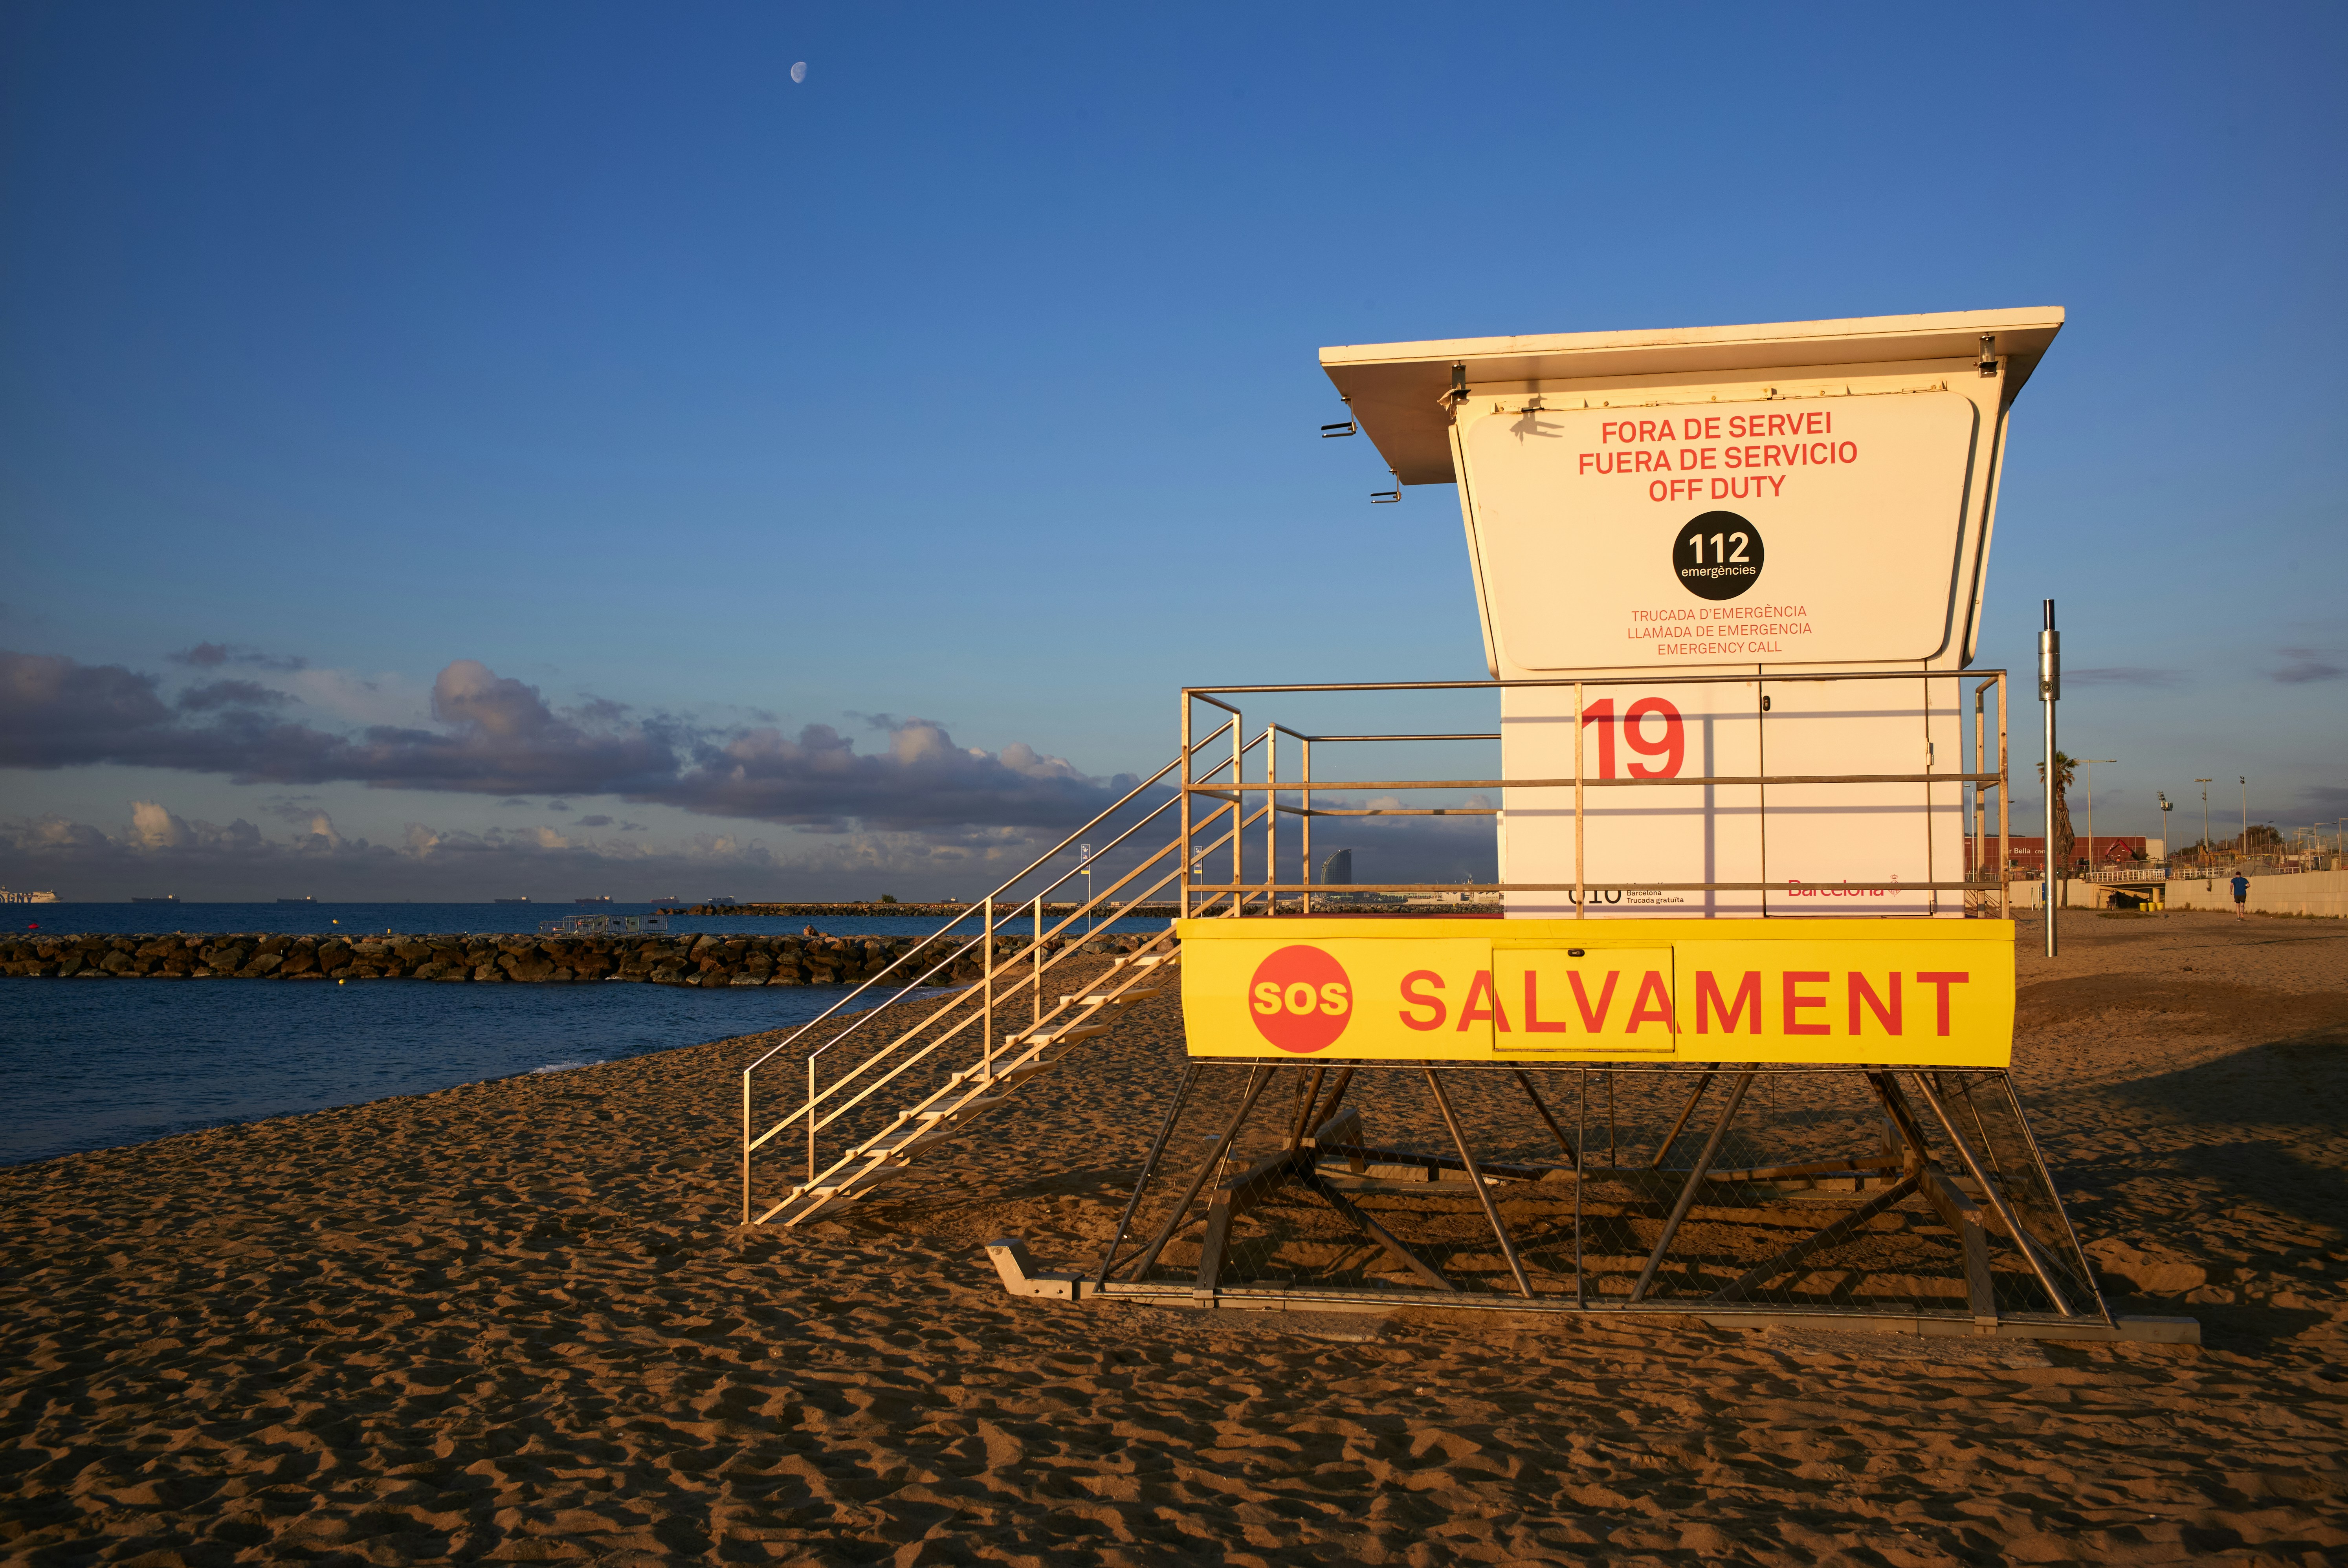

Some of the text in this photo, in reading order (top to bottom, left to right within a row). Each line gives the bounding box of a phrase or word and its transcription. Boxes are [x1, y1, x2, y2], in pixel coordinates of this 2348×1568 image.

[1602, 411, 1831, 444] FORA DE SERVEI
[1579, 441, 1858, 475] FUERA DE SERVICIO
[1649, 474, 1786, 502] OFF DUTY
[1689, 532, 1750, 564] 112
[1681, 564, 1756, 579] emergències
[1632, 609, 1695, 621] TRUCADA
[1628, 623, 1812, 639] LLAMADA DE EMERGENCIA
[1658, 641, 1781, 655] EMERGENCY CALL
[1582, 697, 1685, 779] 19
[1656, 896, 1684, 905] gratuïta
[1253, 982, 1348, 1016] SOS
[1399, 969, 1970, 1037] SALVAMENT
